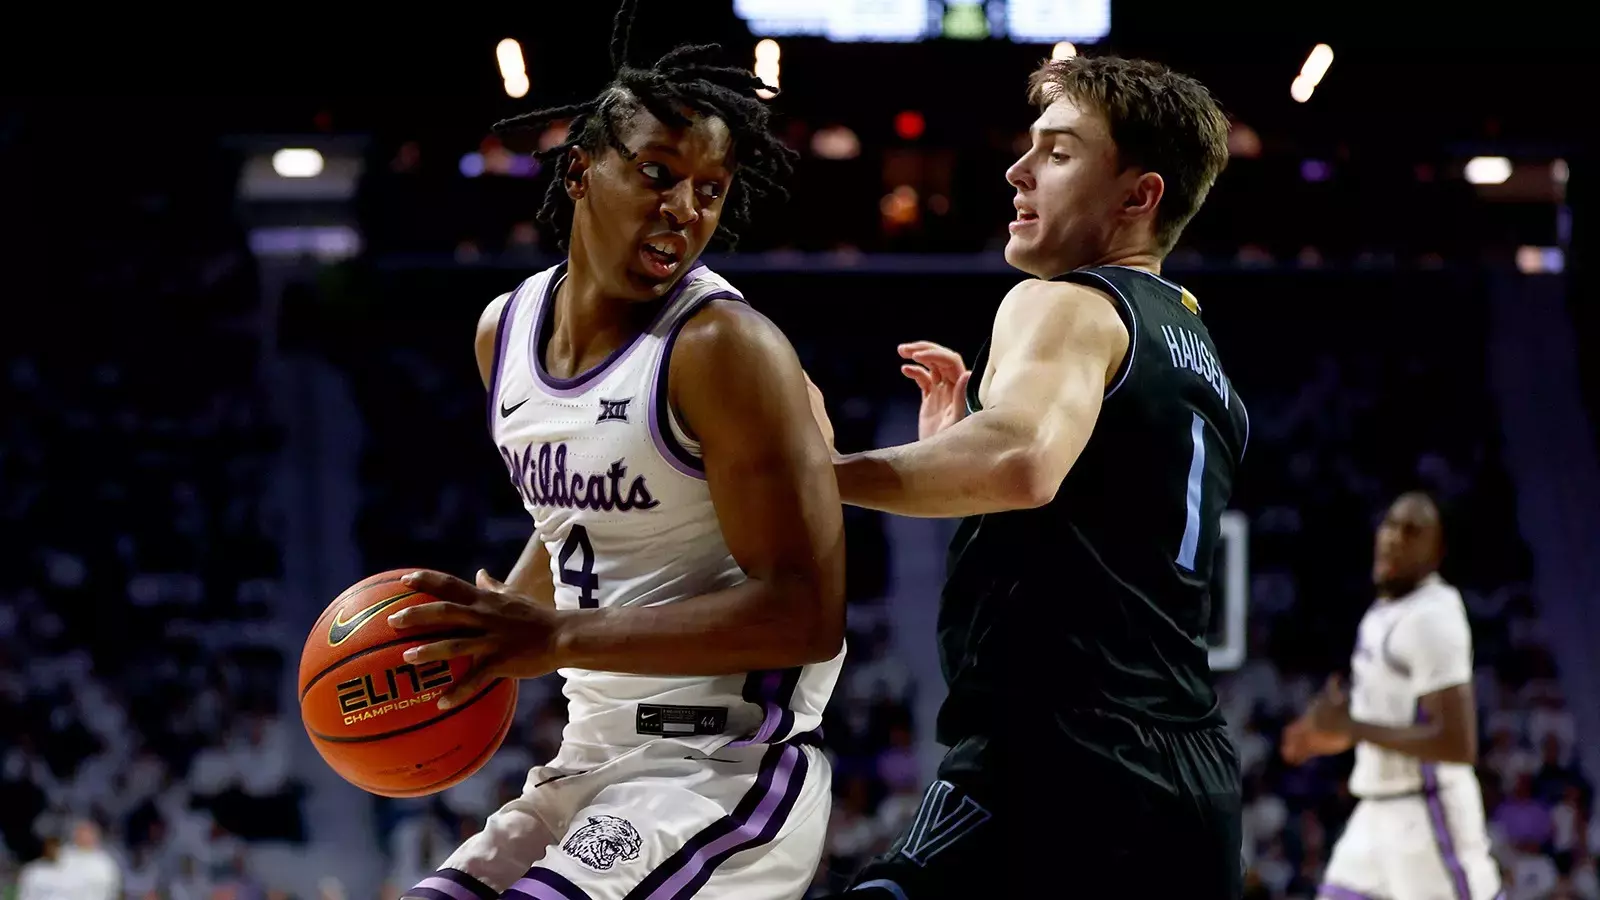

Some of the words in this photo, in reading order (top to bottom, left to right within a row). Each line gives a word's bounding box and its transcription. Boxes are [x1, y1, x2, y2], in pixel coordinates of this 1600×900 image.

[1161, 325, 1230, 409] HAUSEN
[501, 442, 660, 511] Wildcats
[1175, 412, 1205, 571] 1
[558, 524, 599, 609] 4
[336, 660, 453, 716] ELITE
[344, 689, 443, 726] CHAMPIONSH
[701, 716, 715, 728] 44
[901, 780, 992, 867] V
